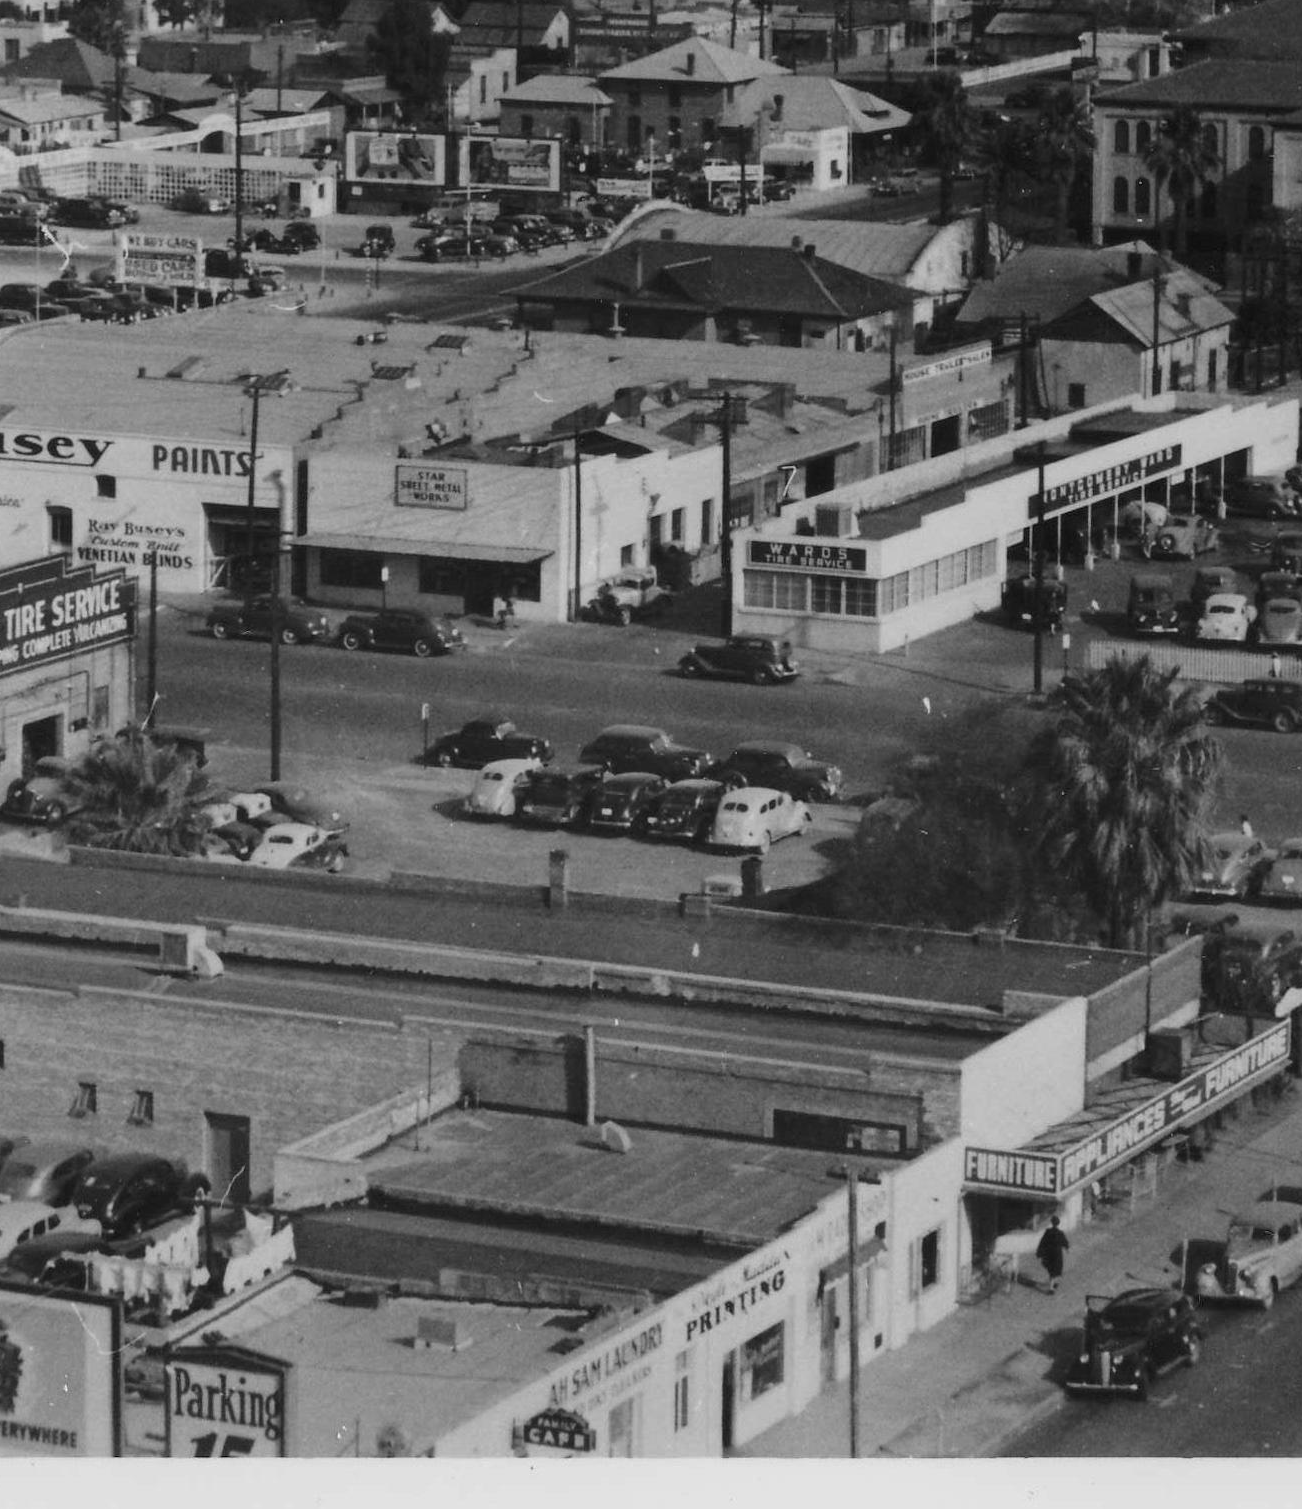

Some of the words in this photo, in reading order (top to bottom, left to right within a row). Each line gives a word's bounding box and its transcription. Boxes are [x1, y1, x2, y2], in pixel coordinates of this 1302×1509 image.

[153, 444, 251, 477] PAINTS
[417, 471, 446, 481] STAR
[400, 480, 430, 491] SHEET
[433, 483, 461, 494] METAL
[413, 492, 451, 503] WORKS
[88, 518, 118, 533] Ray
[124, 521, 185, 538] Busey's
[77, 546, 136, 564] VENETIAN
[763, 553, 793, 565] TIRE
[799, 556, 853, 570] SERVICE
[769, 542, 849, 561] WARDS
[4, 599, 46, 641] TIRE
[51, 579, 121, 628] SERVICE
[22, 627, 72, 660] COMPLETE
[74, 612, 128, 644] VULCANIZING
[1061, 1099, 1167, 1188] APPLIANCES
[1205, 1025, 1290, 1101] FURNITURE
[969, 1153, 1057, 1190] FURNITURE
[686, 1269, 786, 1343] PRINTING
[549, 1376, 569, 1407] AH
[571, 1356, 602, 1396] SAM
[604, 1321, 663, 1378] LAUNDRY
[173, 1366, 280, 1442] Parking
